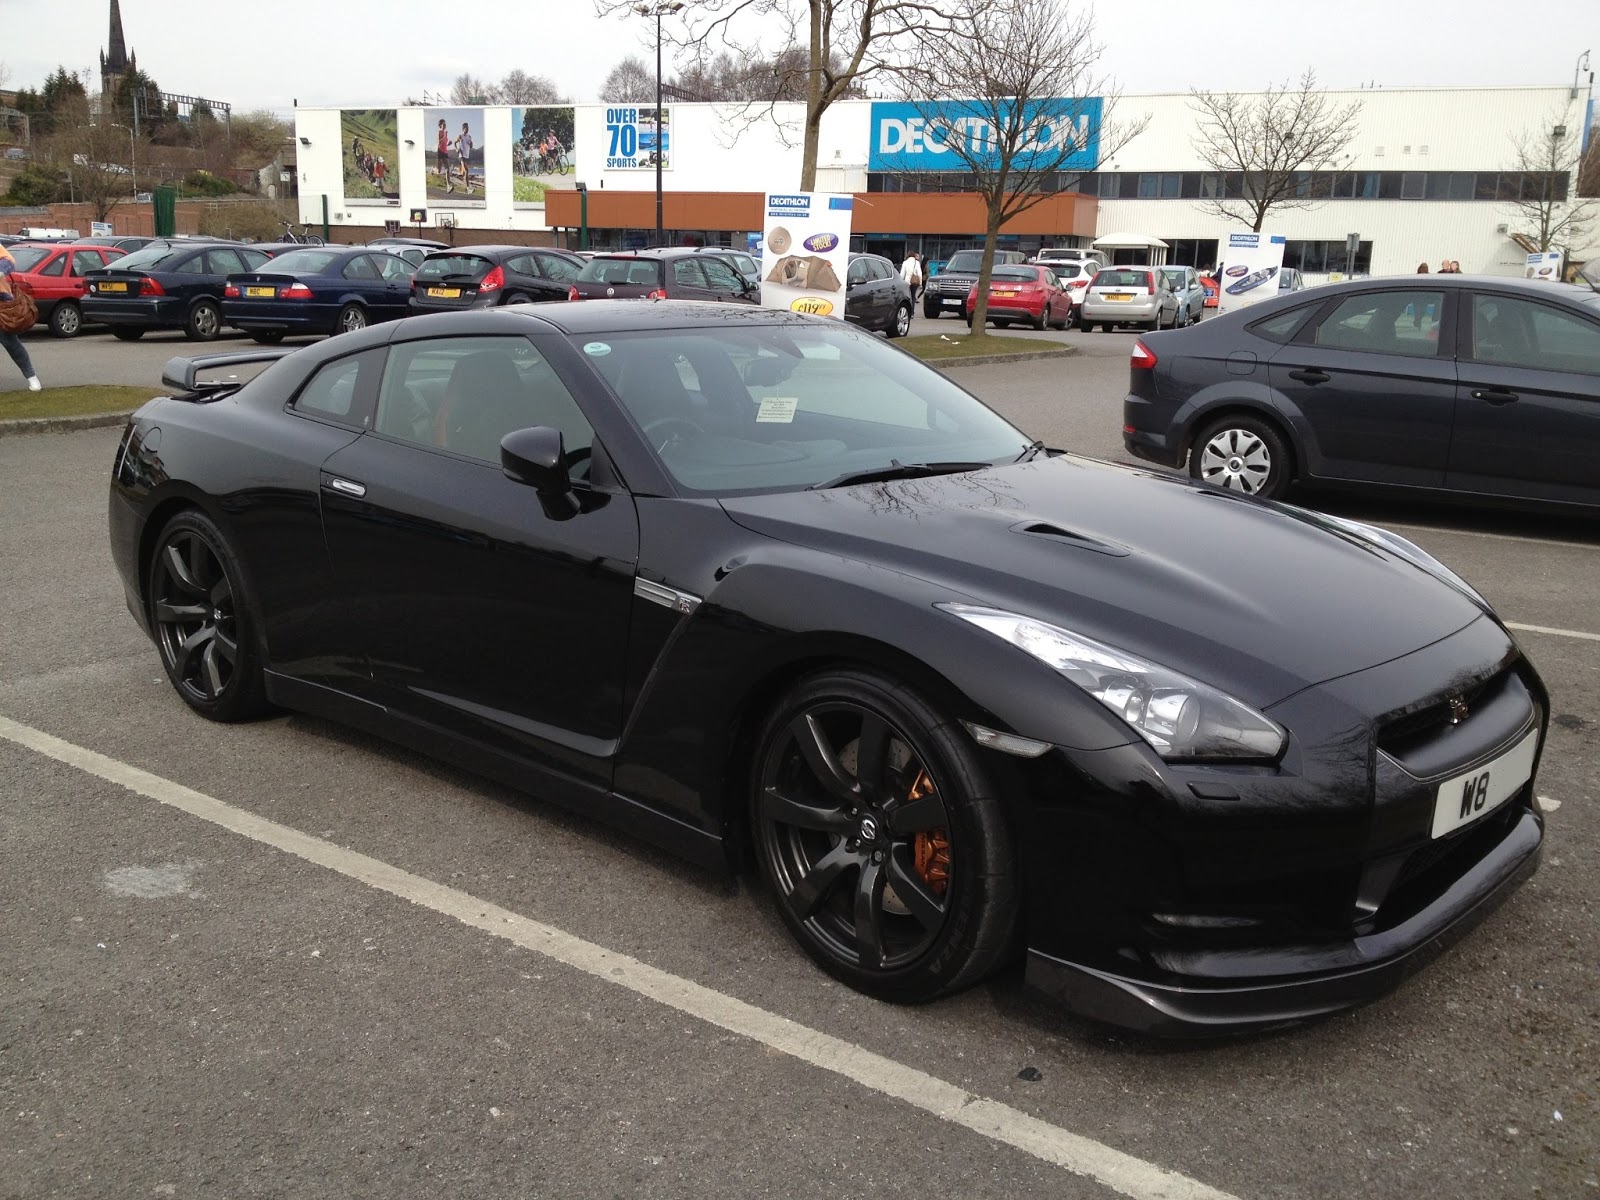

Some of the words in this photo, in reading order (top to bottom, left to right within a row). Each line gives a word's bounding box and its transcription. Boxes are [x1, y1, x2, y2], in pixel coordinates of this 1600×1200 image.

[606, 108, 637, 124] OVER
[606, 124, 637, 157] 70
[879, 114, 1090, 155] DECATHLON
[606, 158, 637, 168] SPORTS
[771, 197, 808, 206] DECATHLON
[1459, 771, 1490, 820] W8
